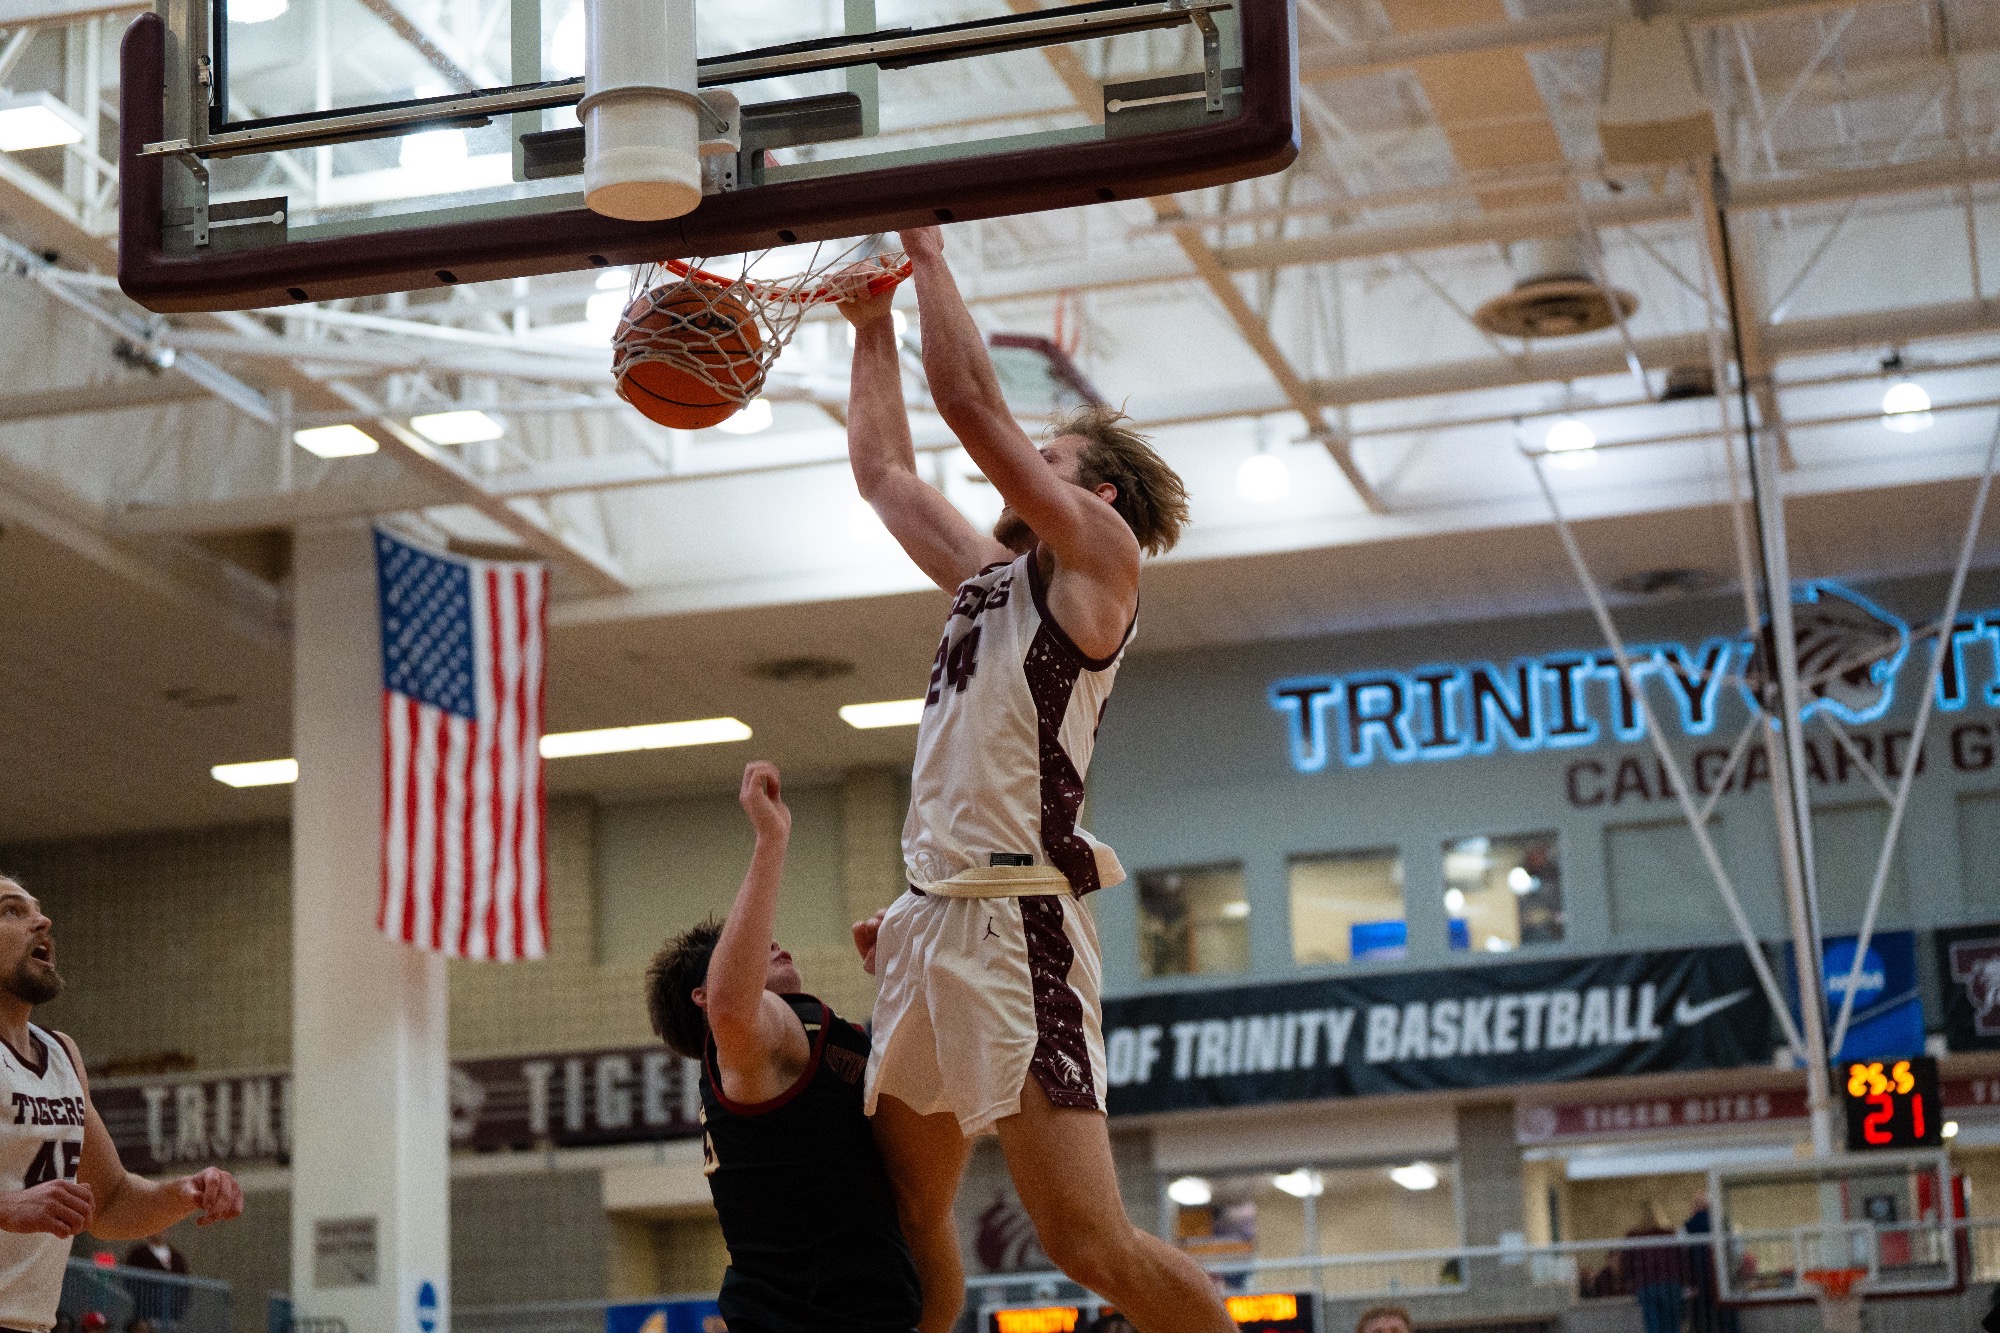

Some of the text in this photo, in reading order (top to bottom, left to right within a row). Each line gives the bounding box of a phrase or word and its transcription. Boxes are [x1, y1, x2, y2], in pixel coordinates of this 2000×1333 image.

[1270, 638, 1733, 772] TRINITY
[1106, 982, 1663, 1087] OF TRINITY BASKETBALL
[12, 1092, 84, 1127] TIGERS
[1863, 1092, 1925, 1144] 21
